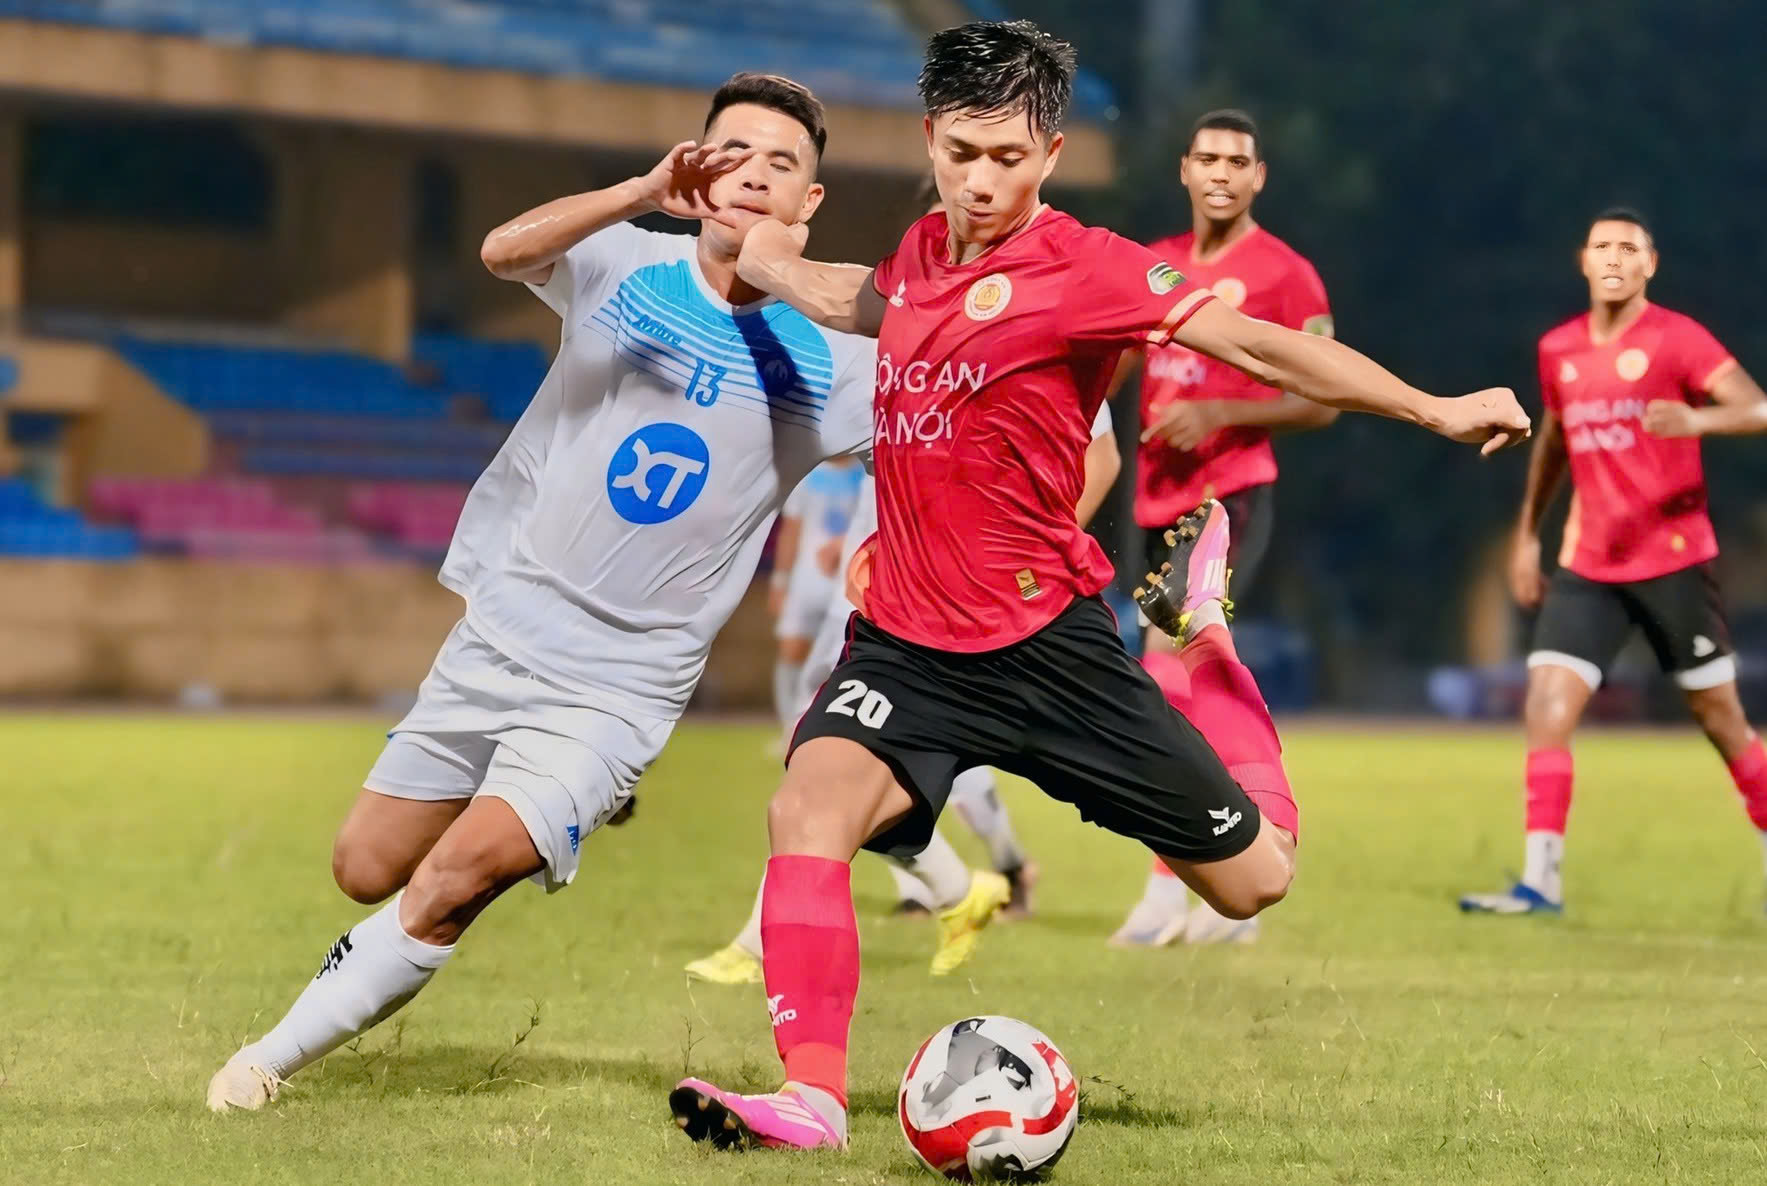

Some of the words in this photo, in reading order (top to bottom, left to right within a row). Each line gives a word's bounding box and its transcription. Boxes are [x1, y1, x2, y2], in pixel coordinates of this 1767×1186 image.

[685, 356, 728, 407] 13
[933, 360, 987, 393] AN
[825, 679, 893, 729] 20
